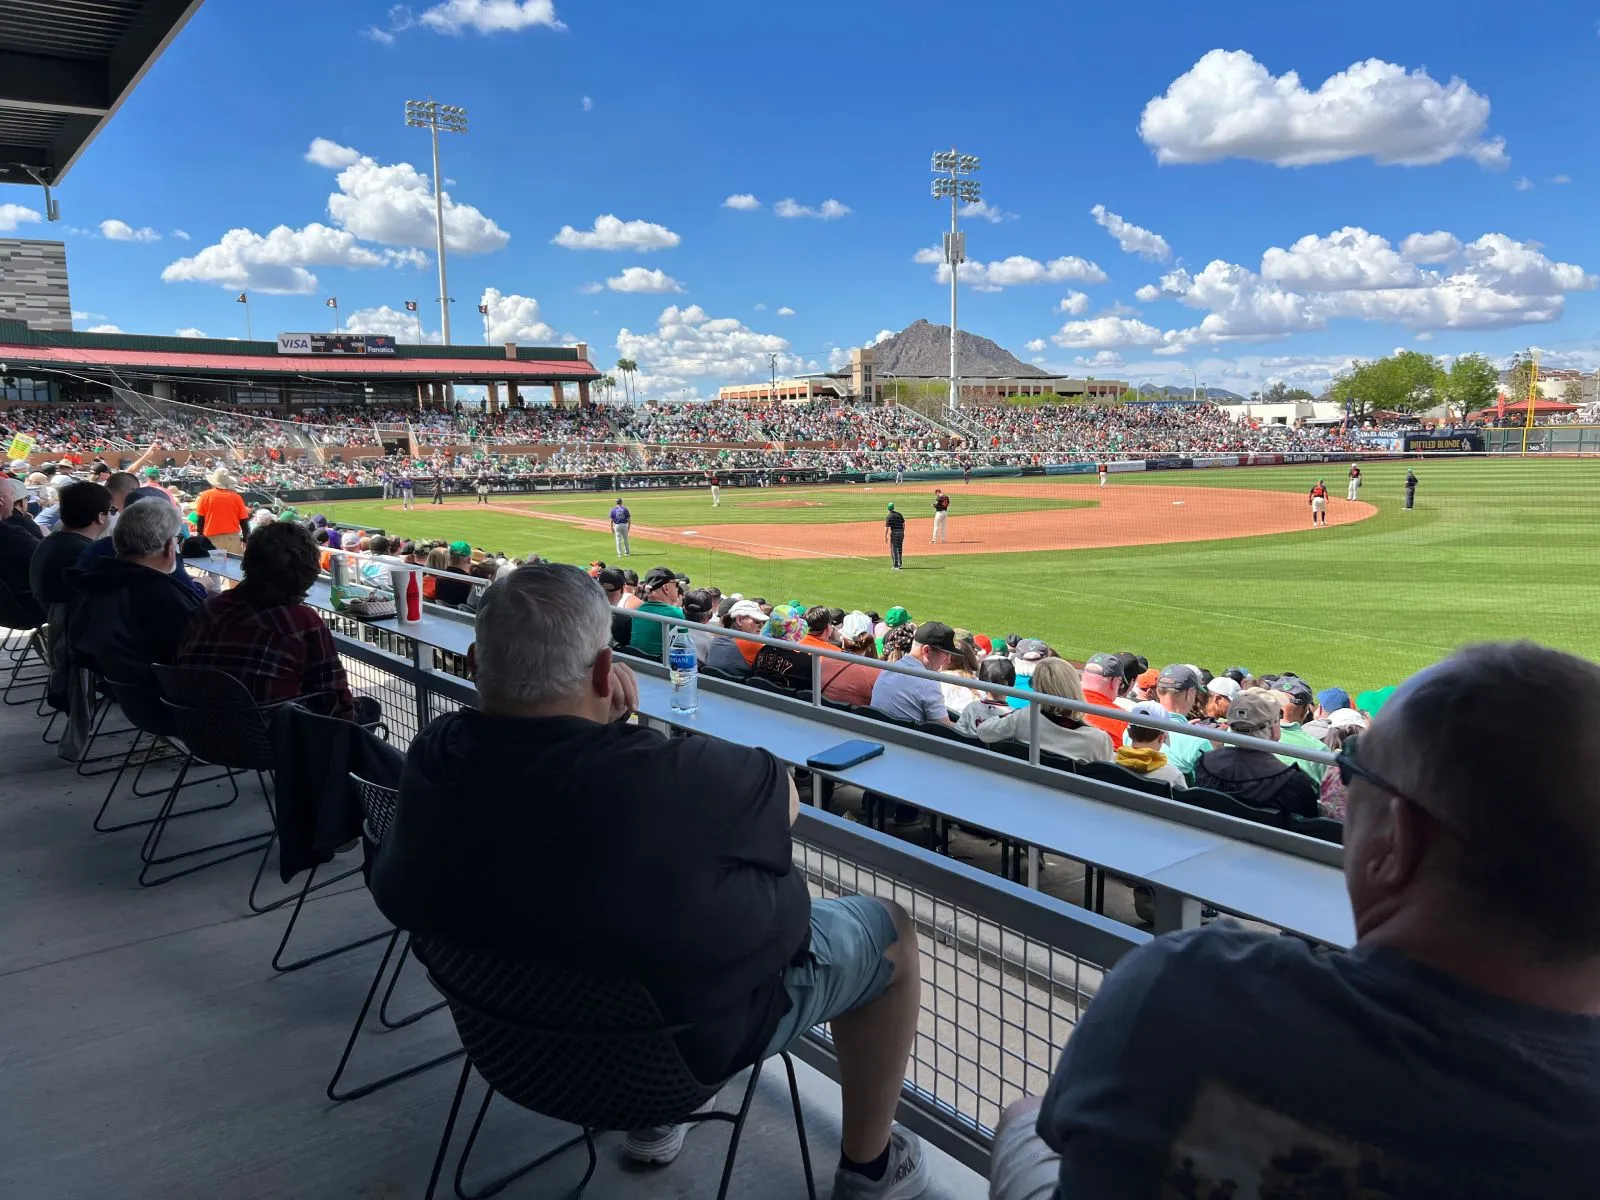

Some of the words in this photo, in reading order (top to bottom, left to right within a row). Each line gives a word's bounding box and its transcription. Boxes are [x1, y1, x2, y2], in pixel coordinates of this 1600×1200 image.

[281, 339, 309, 349] VISA
[367, 345, 395, 353] Fanatics
[1355, 431, 1378, 439] SAMUEL
[1378, 430, 1399, 439] ADAMS
[1409, 440, 1436, 449] BOTTLED
[1437, 439, 1461, 448] BLONDE
[891, 1156, 916, 1185] HOKA
